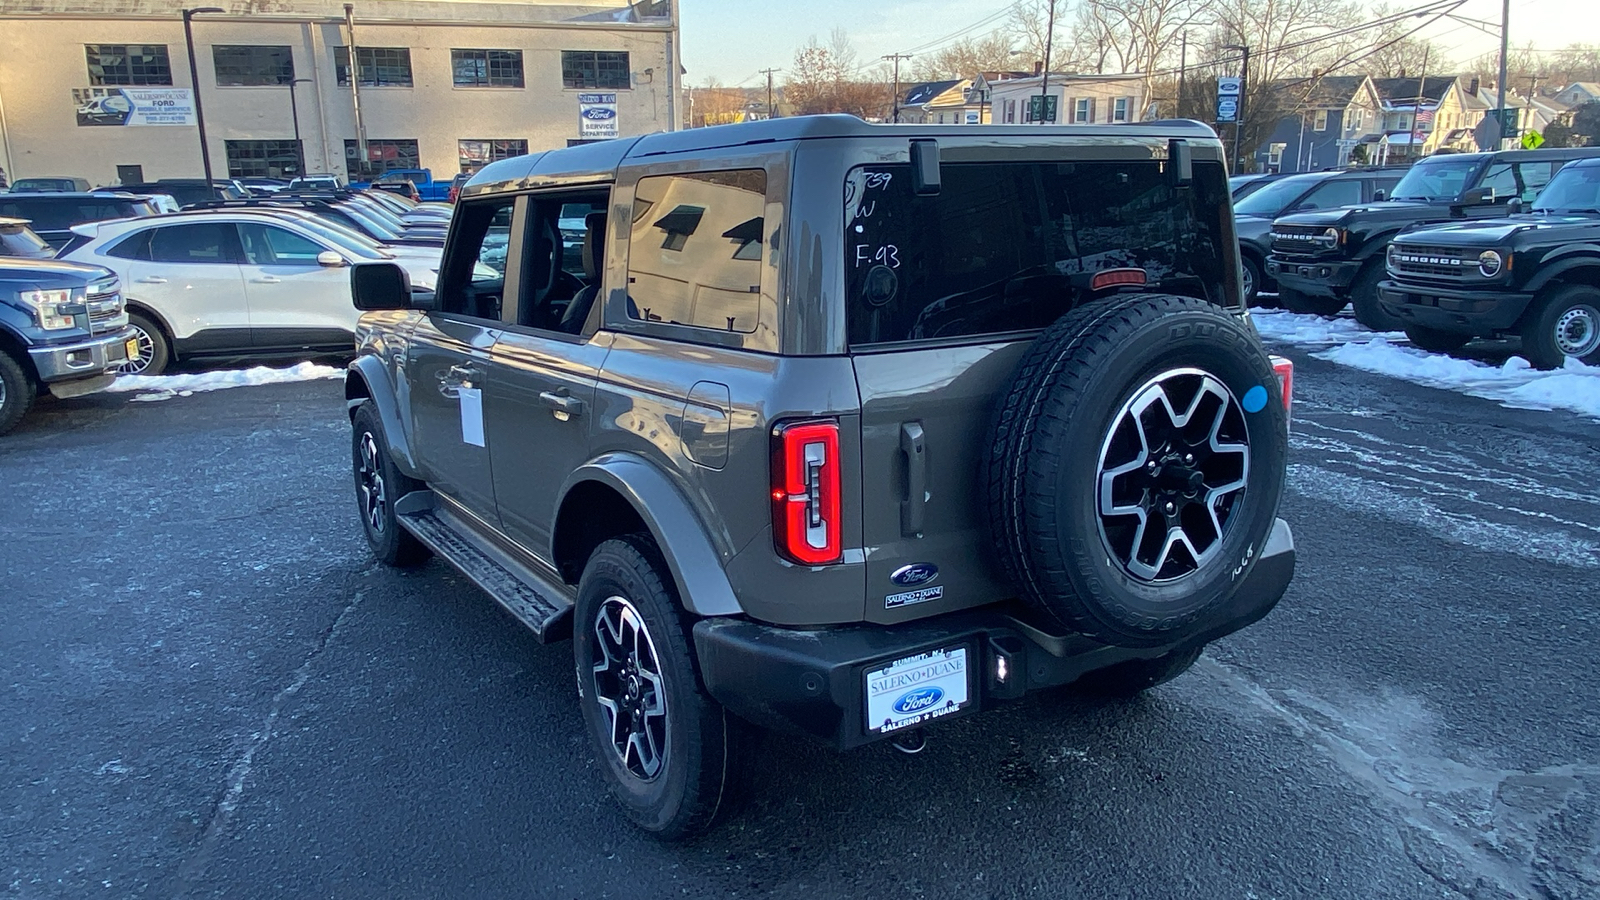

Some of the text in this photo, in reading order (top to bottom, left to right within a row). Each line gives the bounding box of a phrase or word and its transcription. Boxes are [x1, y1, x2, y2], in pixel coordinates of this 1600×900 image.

[1401, 255, 1461, 265] BRONCO
[887, 592, 916, 604] SALERNO
[871, 659, 963, 694] SALERNO DUANE
[902, 691, 935, 711] Ford
[880, 703, 960, 733] SALERNO DUANE
